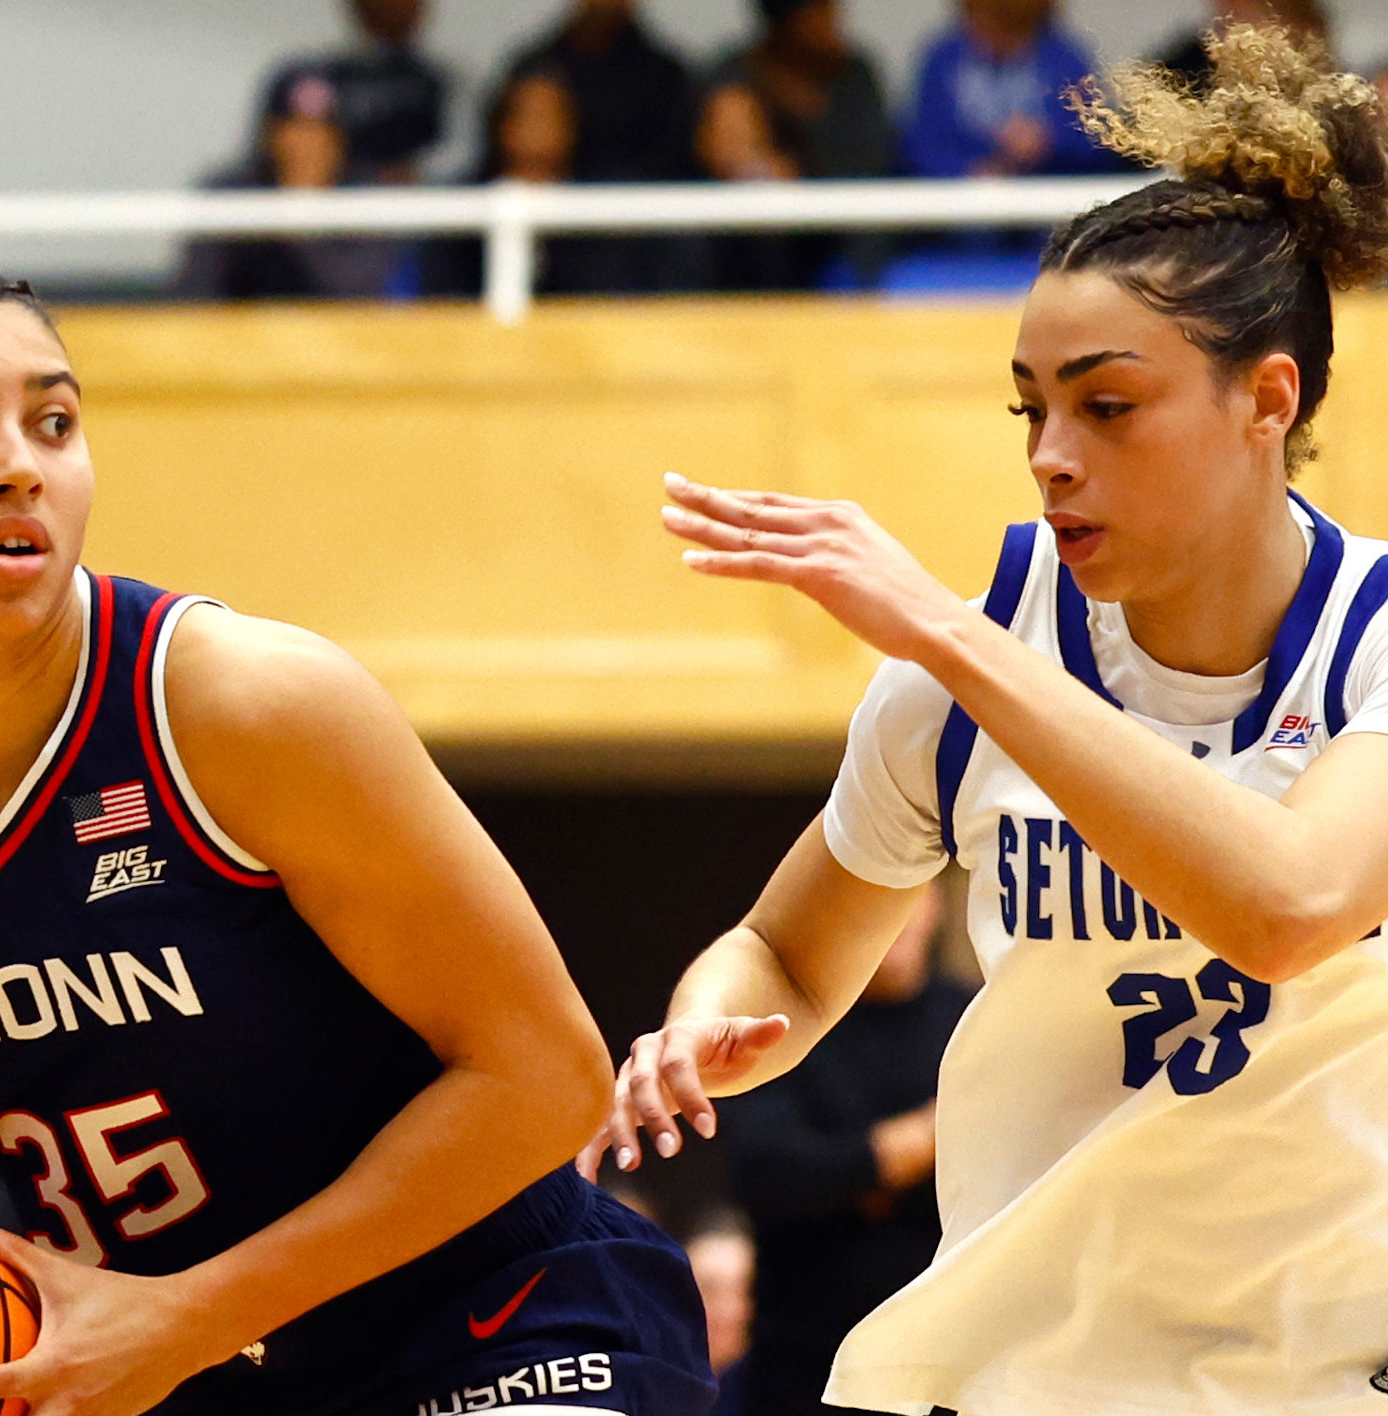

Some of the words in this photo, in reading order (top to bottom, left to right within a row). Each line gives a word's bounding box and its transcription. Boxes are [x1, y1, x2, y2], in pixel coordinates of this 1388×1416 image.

[89, 859, 168, 893] EAST
[95, 845, 149, 874] BIG
[1106, 957, 1272, 1096] 23
